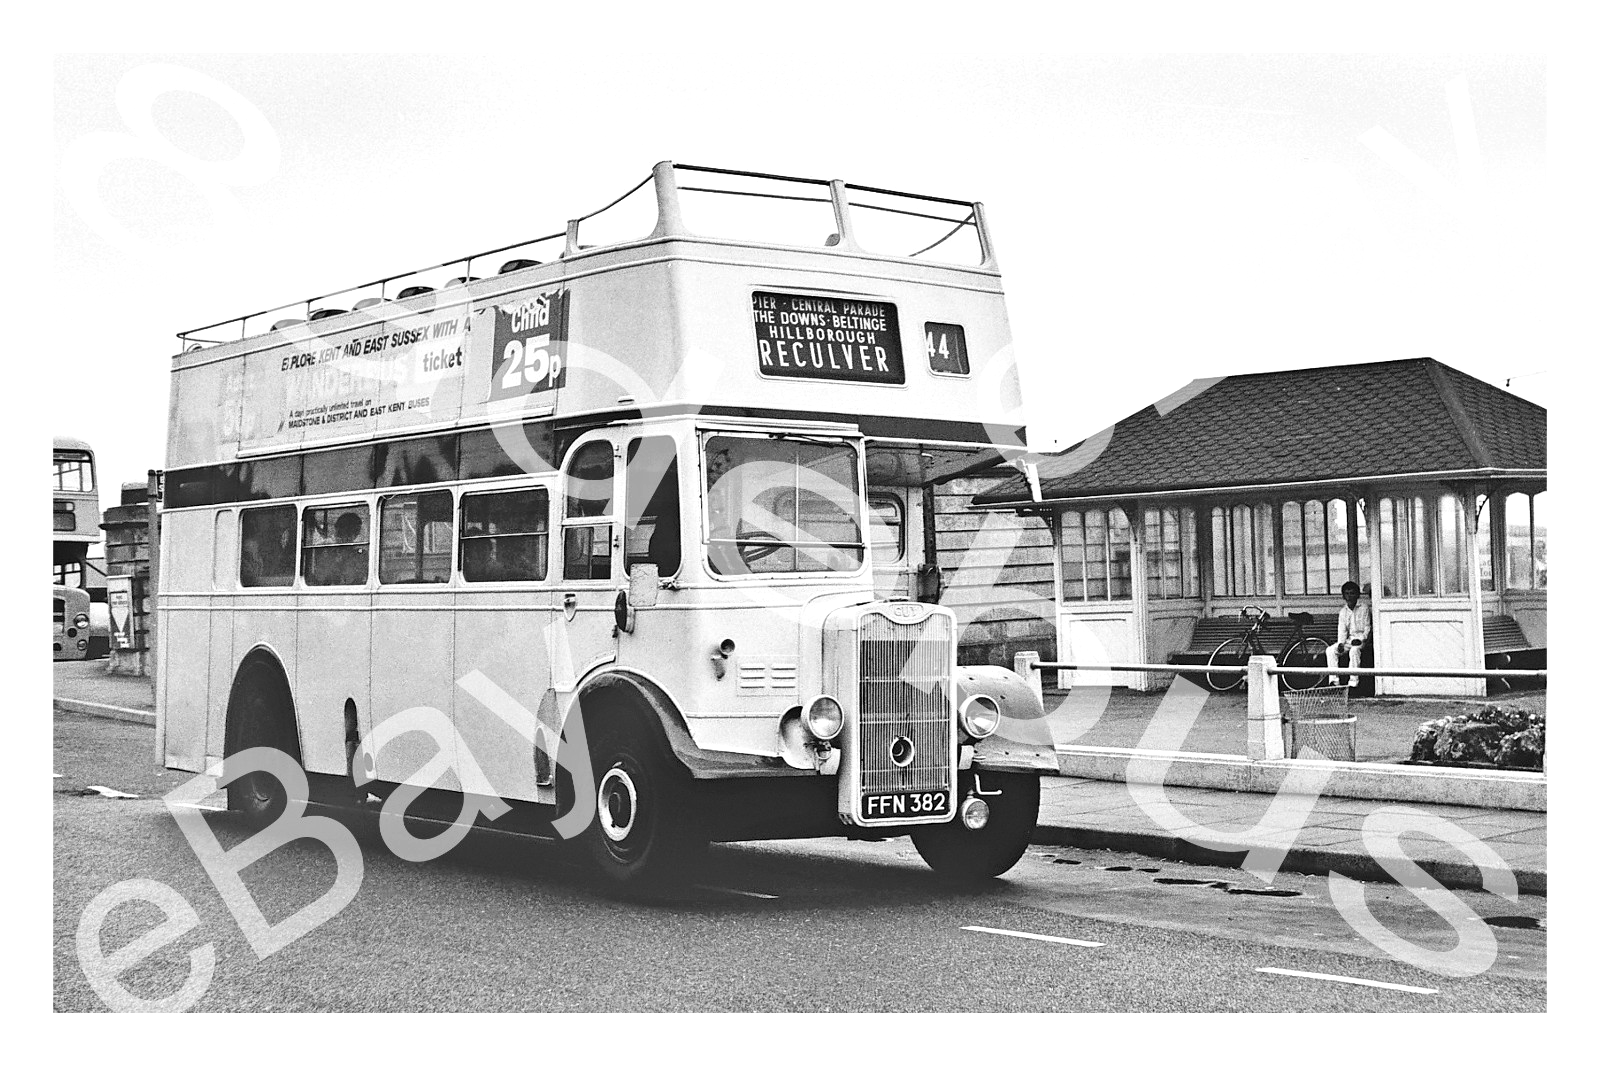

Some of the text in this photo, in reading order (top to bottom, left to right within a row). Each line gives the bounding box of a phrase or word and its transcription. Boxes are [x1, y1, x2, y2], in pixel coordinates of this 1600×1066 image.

[753, 310, 775, 323] THE
[791, 299, 837, 313] CENTRAL
[843, 303, 885, 317] PARADE
[281, 317, 471, 371] EPLORE KENT AND EAST SUSSEX WITH A
[769, 325, 876, 344] HILLBOROUGH
[423, 347, 462, 372] ticket
[501, 333, 562, 389] 25p
[759, 340, 889, 372] RECULVER
[288, 416, 320, 428] MAIDSTONE
[327, 411, 353, 423] DISTRICT
[353, 409, 368, 419] AND
[370, 405, 387, 416] EAST
[388, 402, 406, 413] KENT
[408, 397, 430, 410] BUSES
[867, 792, 946, 815] FFN 382
